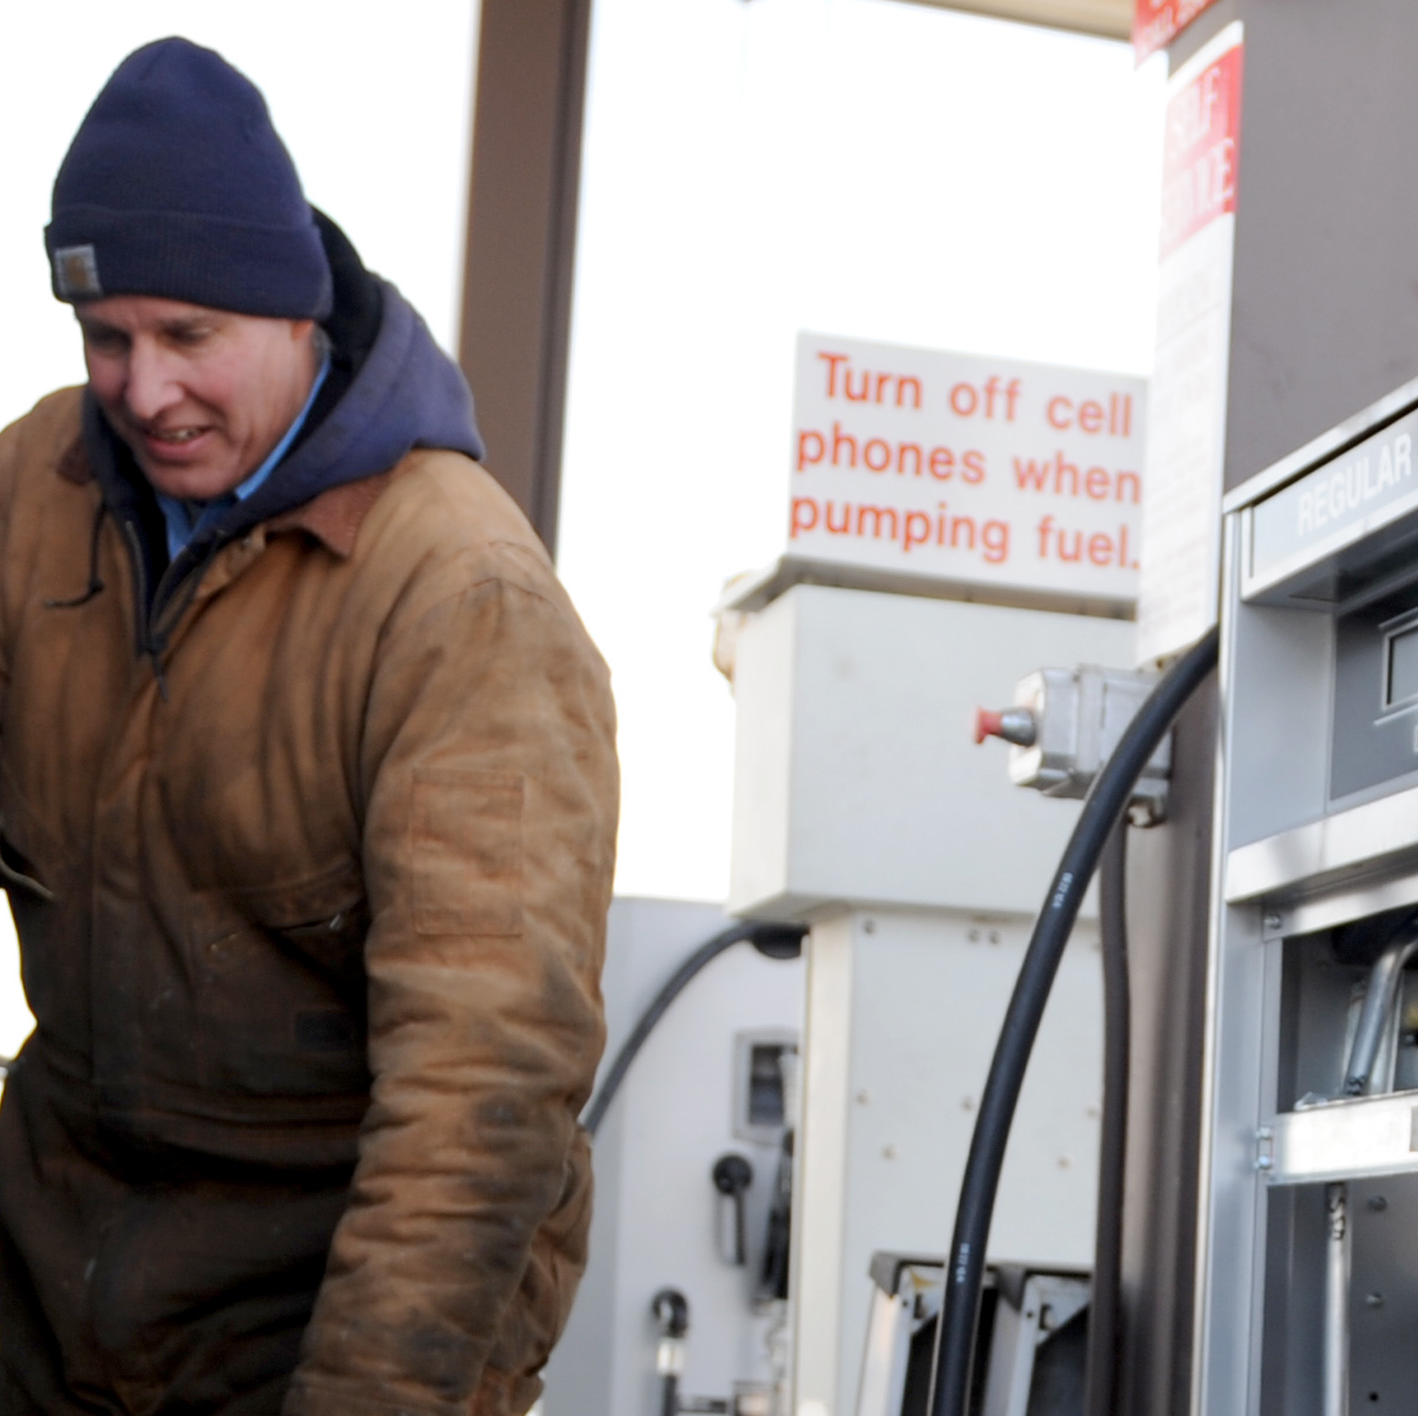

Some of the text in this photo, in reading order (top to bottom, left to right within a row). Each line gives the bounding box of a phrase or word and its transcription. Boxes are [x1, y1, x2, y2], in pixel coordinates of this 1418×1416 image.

[817, 351, 1133, 438] Turn off cell
[797, 422, 1141, 504] phones when
[1298, 434, 1412, 536] REGULAR
[790, 496, 1141, 570] pumping fuel.
